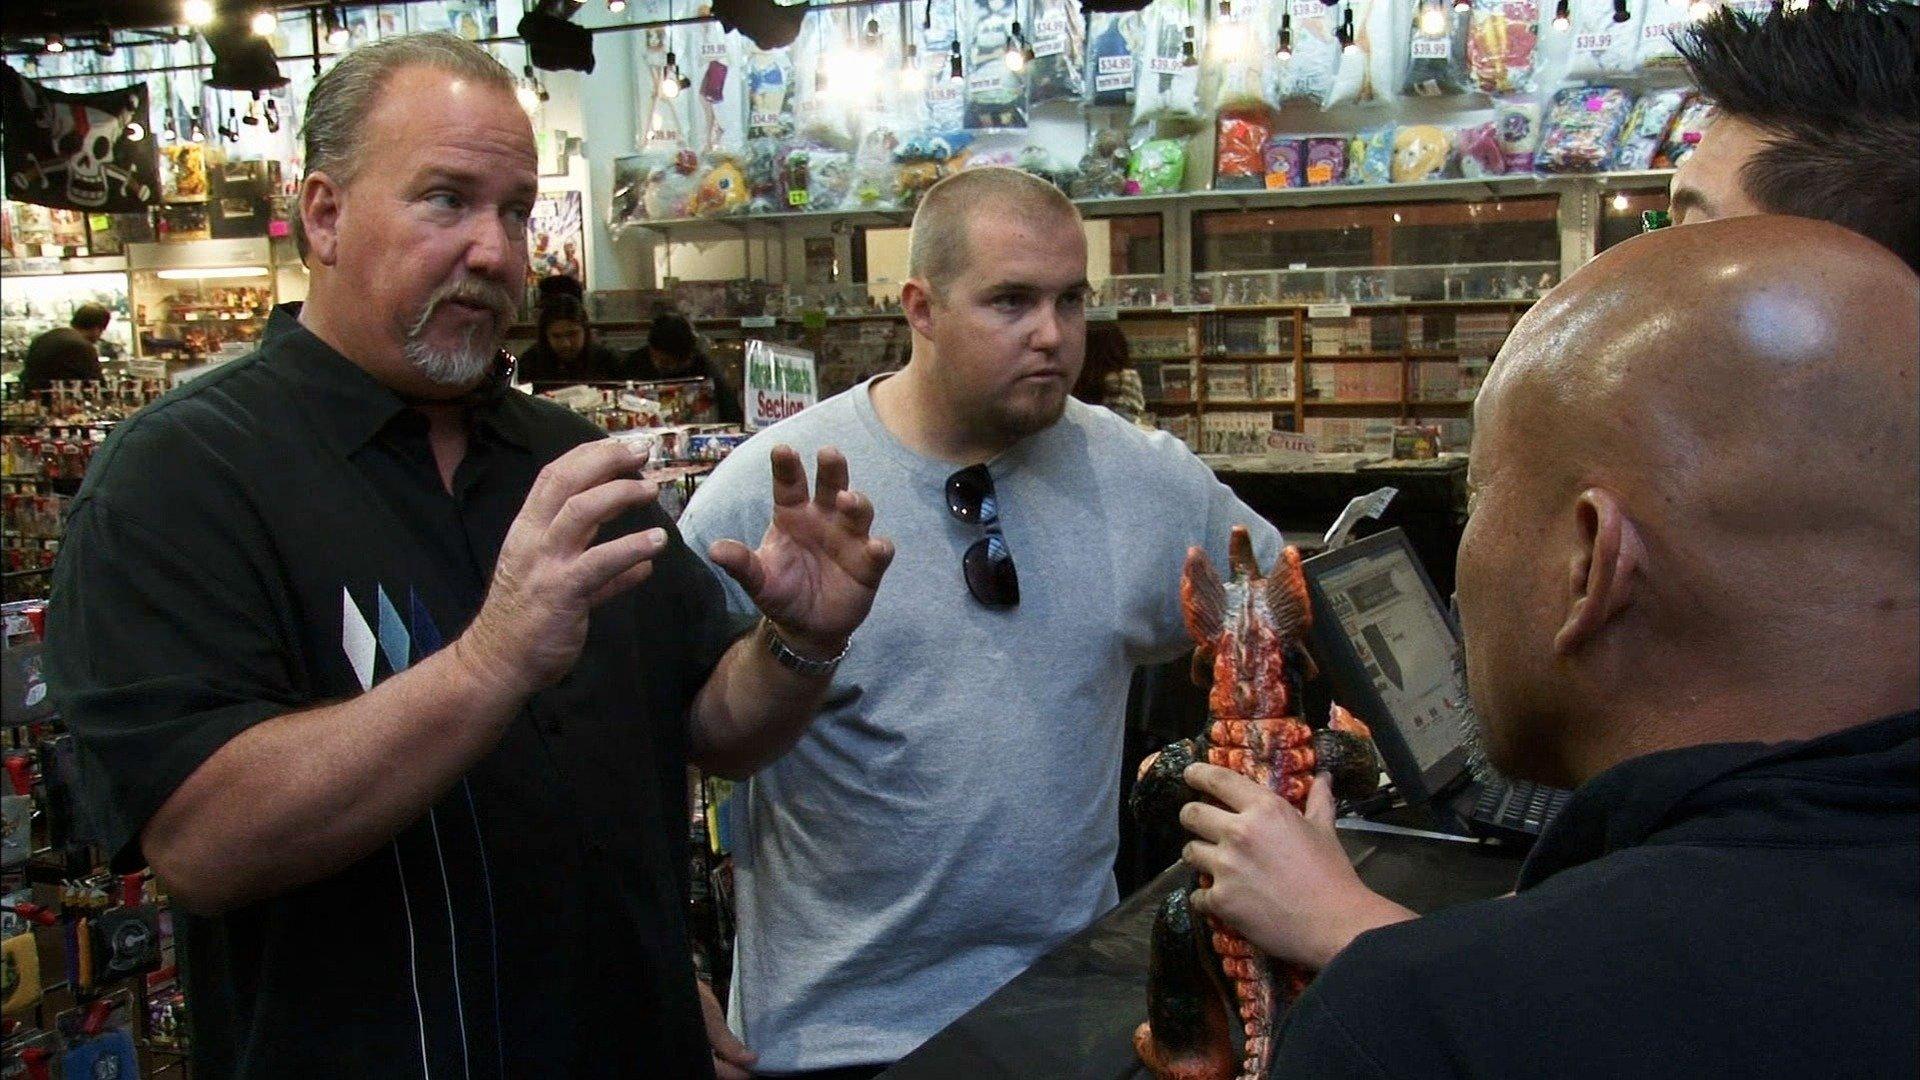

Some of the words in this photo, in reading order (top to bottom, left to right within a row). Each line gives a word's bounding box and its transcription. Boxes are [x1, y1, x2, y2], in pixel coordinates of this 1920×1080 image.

[1576, 34, 1612, 49] $39.99
[1414, 43, 1445, 55] $39.99
[1100, 57, 1131, 71] $34.99
[758, 391, 805, 419] Section
